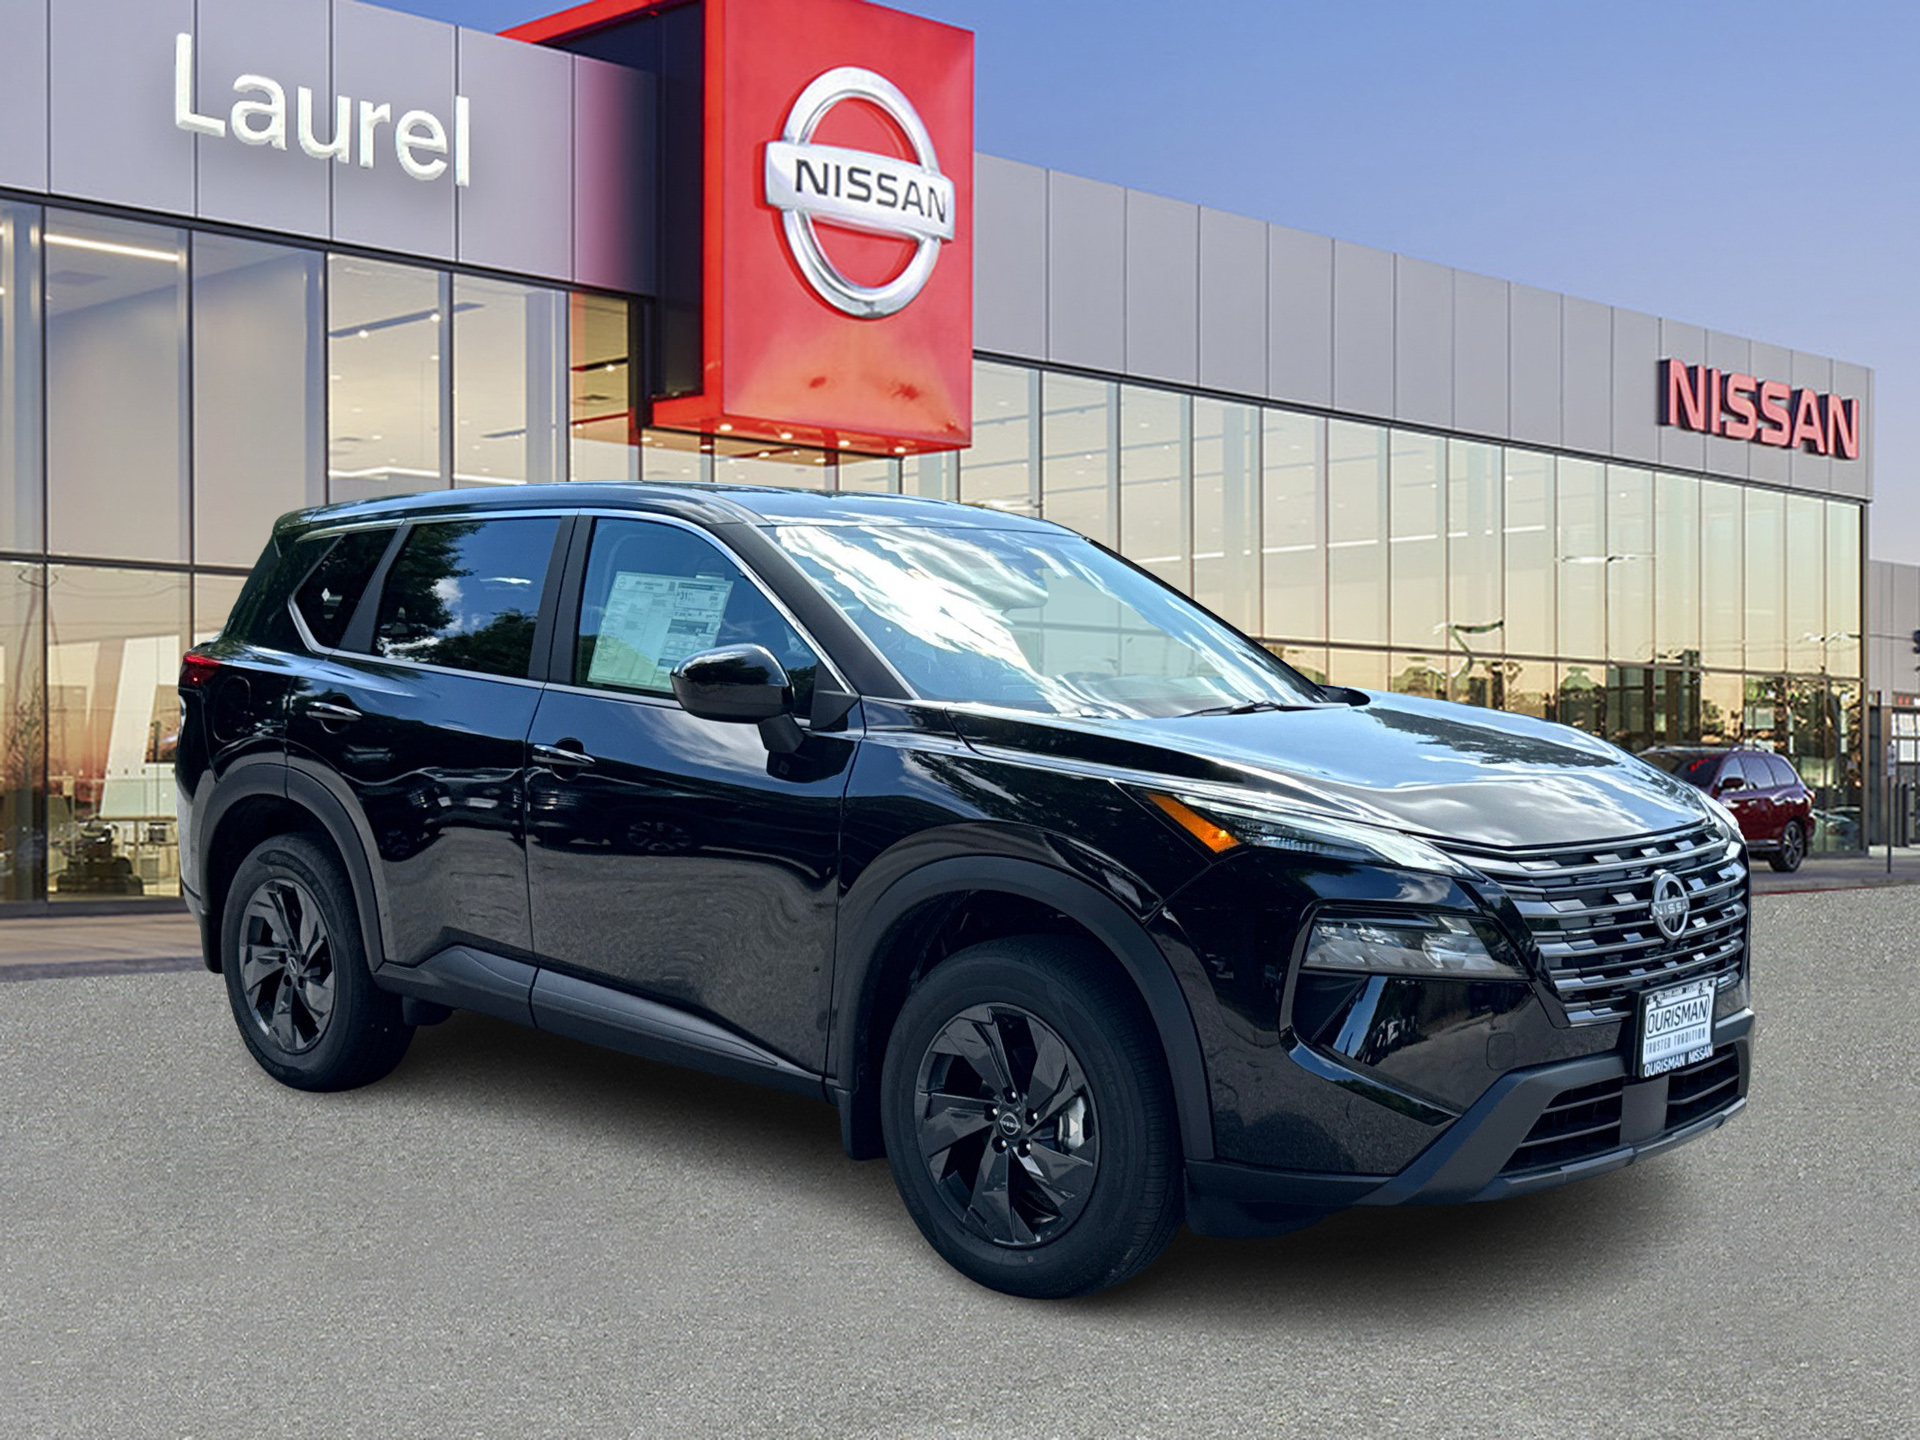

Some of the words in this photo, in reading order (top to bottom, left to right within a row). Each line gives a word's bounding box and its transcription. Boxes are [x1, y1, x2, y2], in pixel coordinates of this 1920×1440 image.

[175, 33, 469, 188] Laurel
[795, 158, 947, 224] NISSAN
[1660, 357, 1860, 460] NISSAN
[1653, 901, 1688, 918] NISS
[1646, 999, 1709, 1035] OURISMAN
[1645, 1036, 1671, 1055] TRUSTED
[1674, 1027, 1706, 1046] TRADITION
[1644, 1053, 1686, 1078] OURISMAN
[1688, 1044, 1714, 1064] NISSAN
